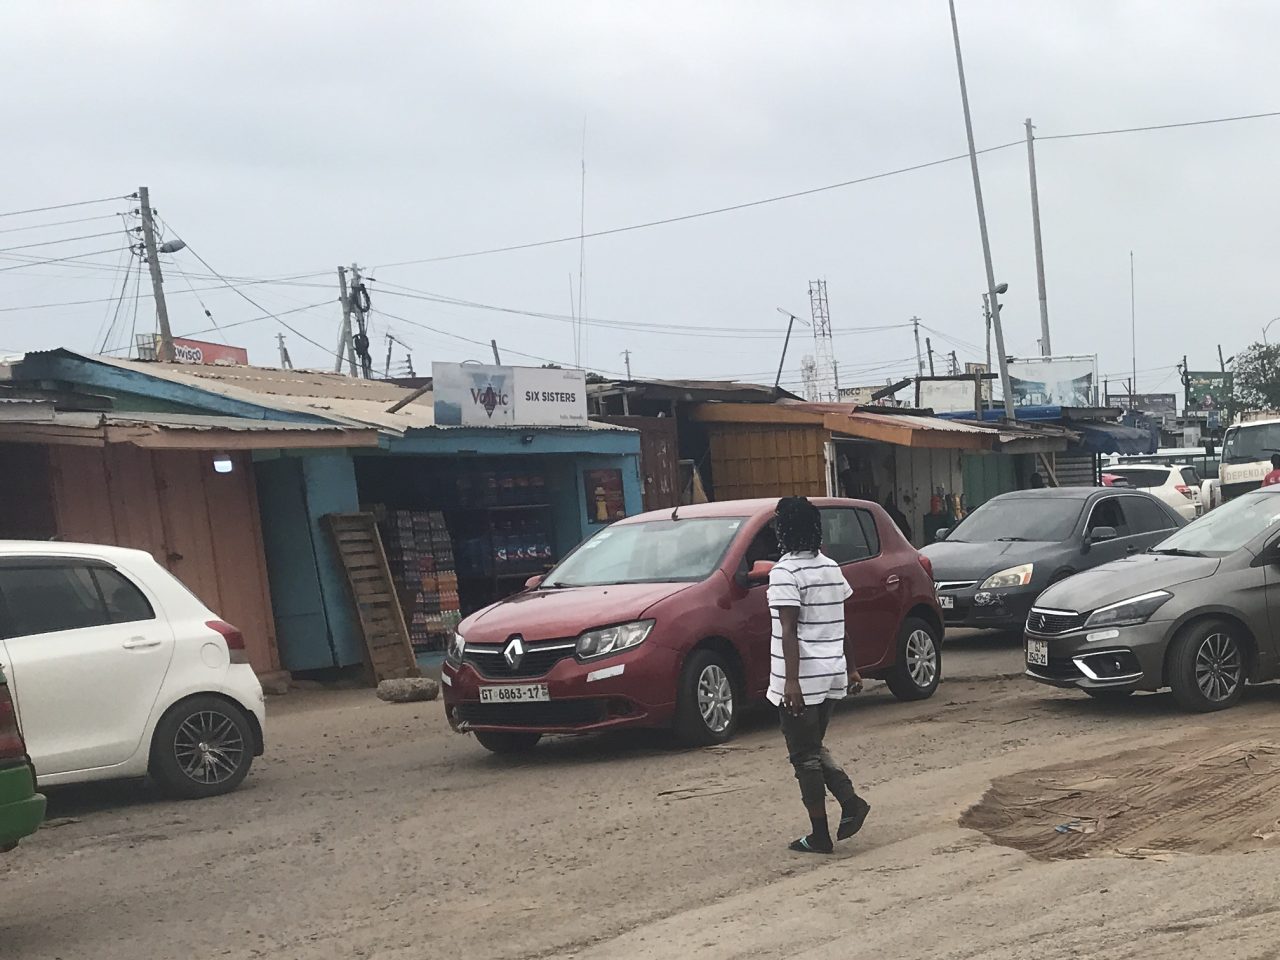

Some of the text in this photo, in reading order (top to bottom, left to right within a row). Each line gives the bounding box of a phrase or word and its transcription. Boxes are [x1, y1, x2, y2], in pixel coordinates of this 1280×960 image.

[525, 391, 576, 403] SIX SISTERS
[481, 688, 493, 701] GT
[498, 685, 540, 700] 6863-17
